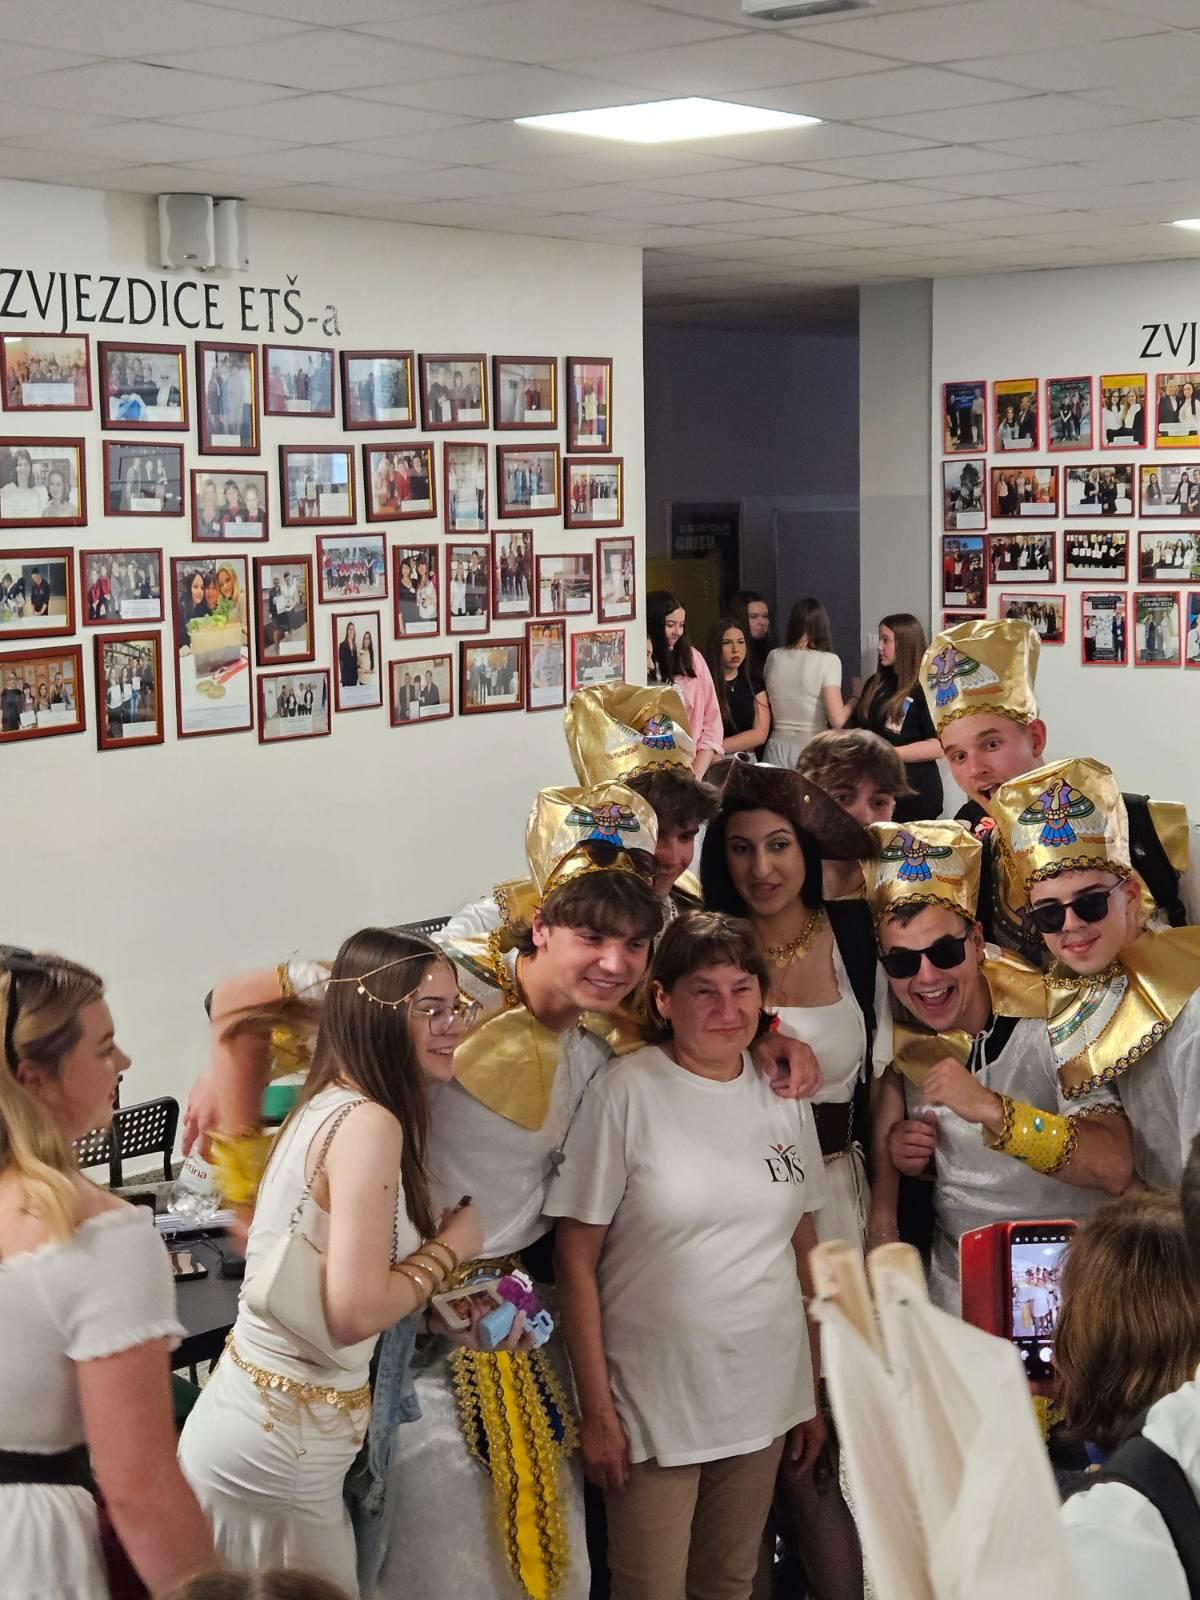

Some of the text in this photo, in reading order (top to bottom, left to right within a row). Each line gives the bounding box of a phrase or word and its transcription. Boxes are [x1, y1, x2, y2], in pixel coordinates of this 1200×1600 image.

[0, 268, 342, 337] ZVJEZDICE ETŠ-a
[1140, 321, 1198, 367] ZVJ
